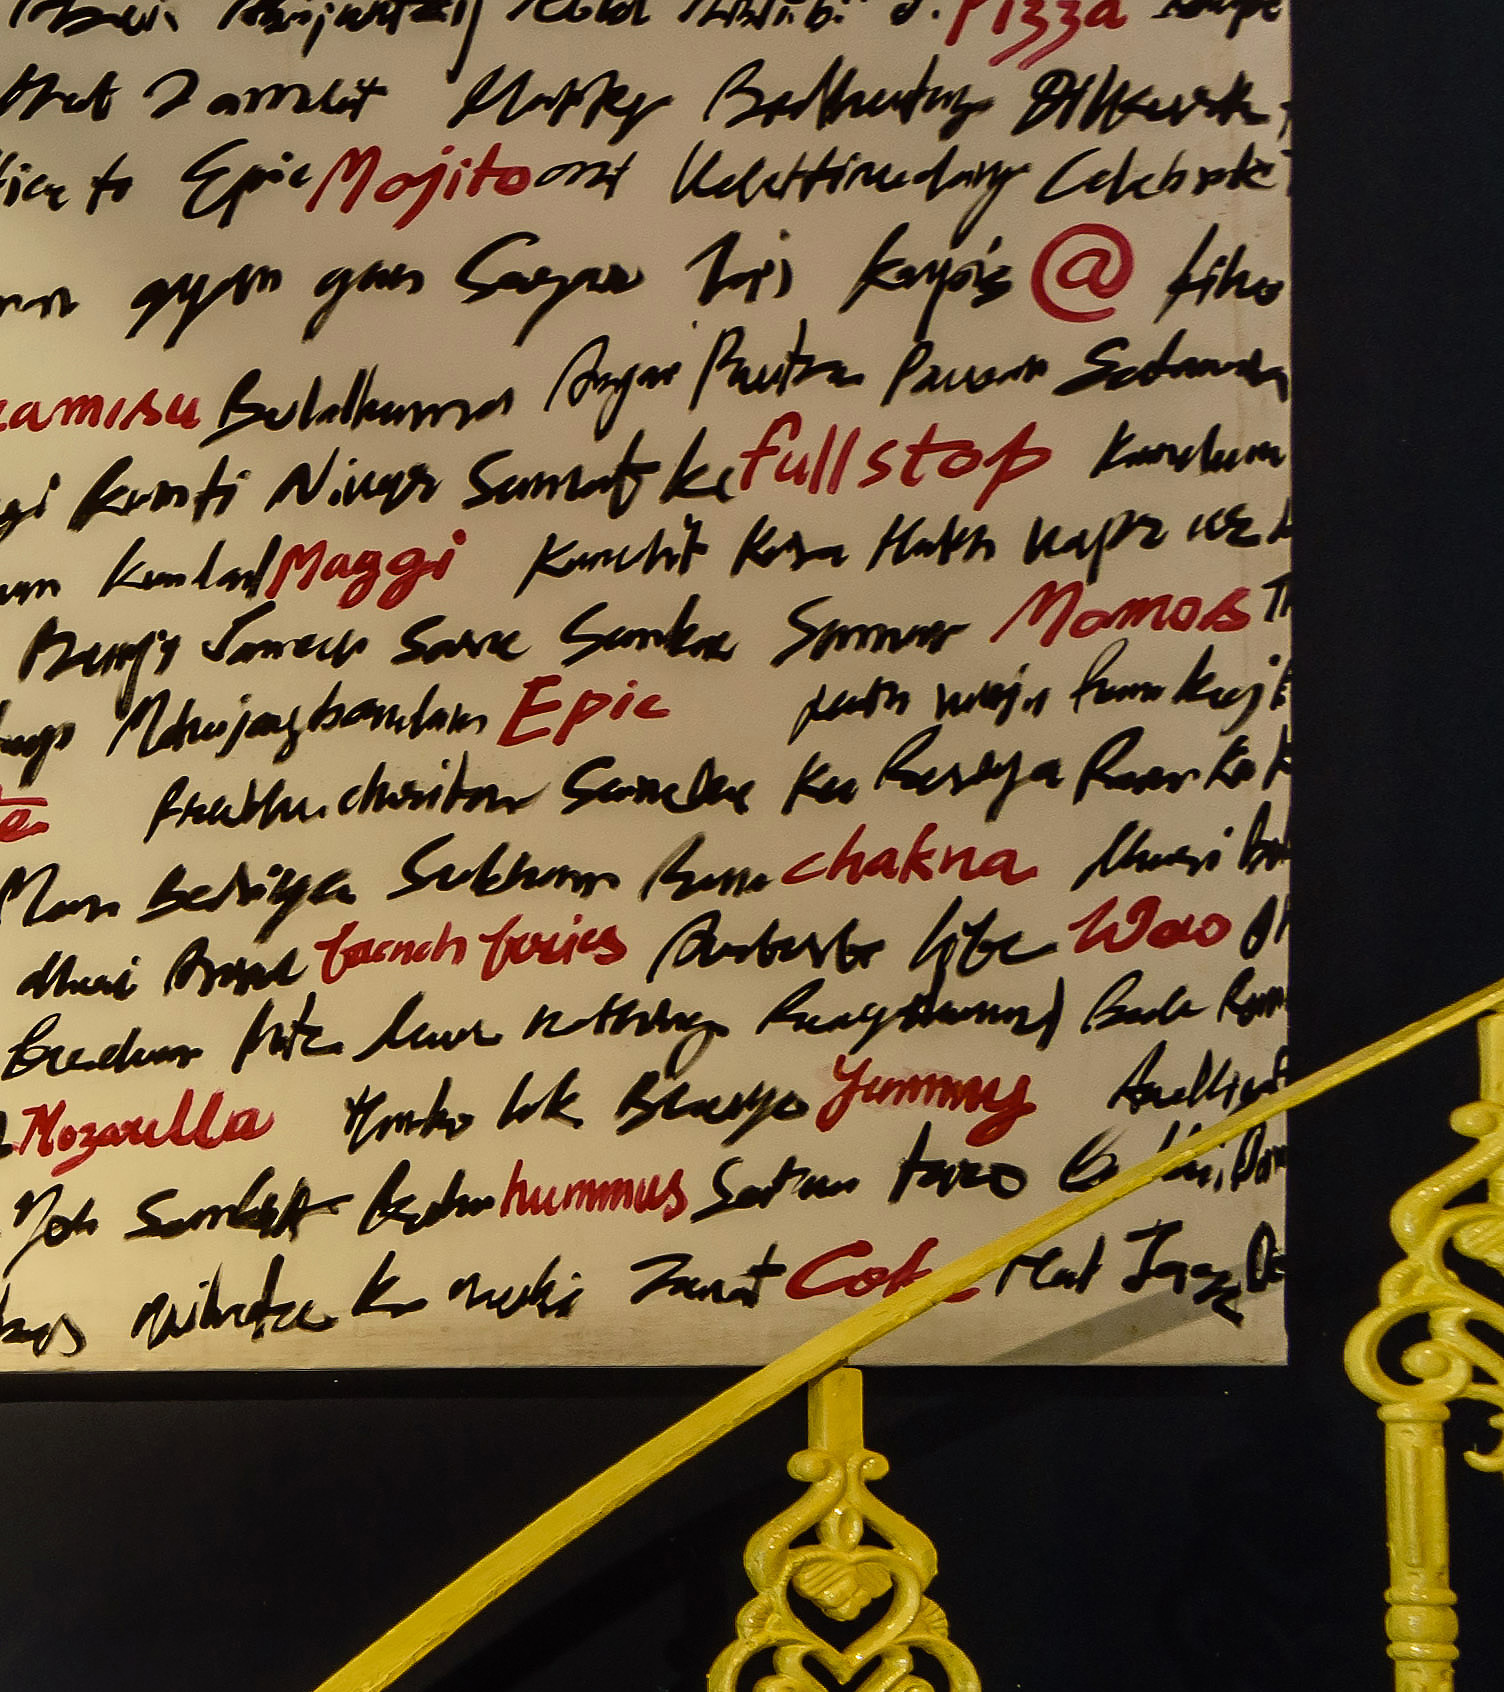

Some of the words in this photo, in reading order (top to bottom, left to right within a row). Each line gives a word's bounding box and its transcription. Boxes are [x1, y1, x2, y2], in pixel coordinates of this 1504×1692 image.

[305, 142, 532, 230] Mojito
[263, 528, 467, 611] Maggi
[990, 580, 1252, 648] Momos
[497, 674, 670, 747] Epic
[781, 822, 1039, 886] chakna
[815, 1055, 1037, 1147] Yummy
[499, 1159, 689, 1222] hummus
